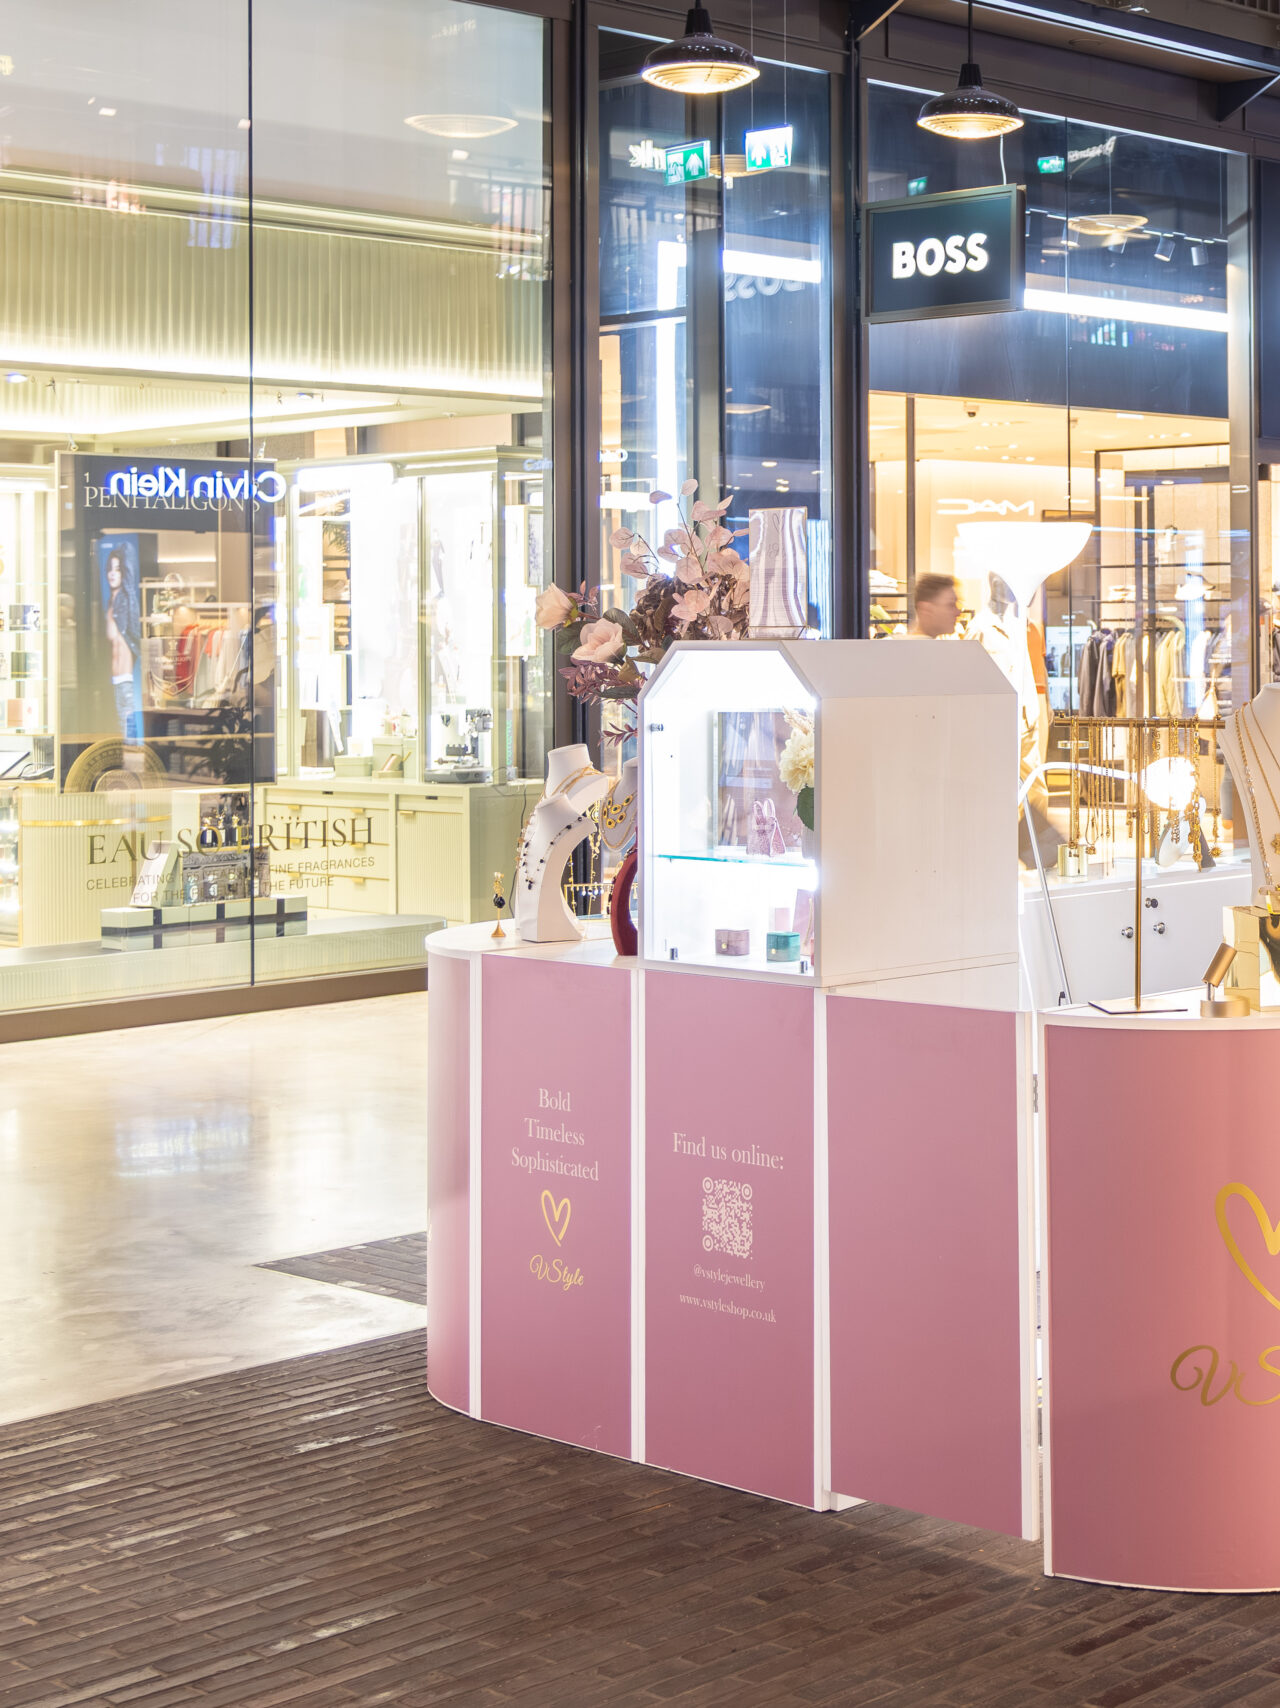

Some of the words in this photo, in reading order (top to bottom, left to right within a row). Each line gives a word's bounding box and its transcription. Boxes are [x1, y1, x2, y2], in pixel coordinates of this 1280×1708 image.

[892, 233, 988, 279] BOSS
[84, 486, 260, 513] PENHALIGONS
[88, 831, 163, 865] EAU
[177, 827, 222, 859] SO
[86, 871, 174, 891] CELEBRATING
[269, 862, 296, 875] FINE
[298, 856, 375, 874] FRAGRANCES
[133, 890, 159, 904] FOR
[163, 888, 185, 902] THE
[264, 879, 286, 892] THE
[290, 875, 334, 890] FUTURE
[538, 1088, 571, 1112] Bold
[524, 1117, 585, 1146] Timeless
[511, 1146, 599, 1181] Sophisticated
[672, 1132, 706, 1157] Find
[711, 1144, 727, 1160] us
[731, 1144, 784, 1170] online:
[693, 1263, 766, 1292] @vstylejewellery
[679, 1294, 777, 1323] www.vstyleshop.co.uk
